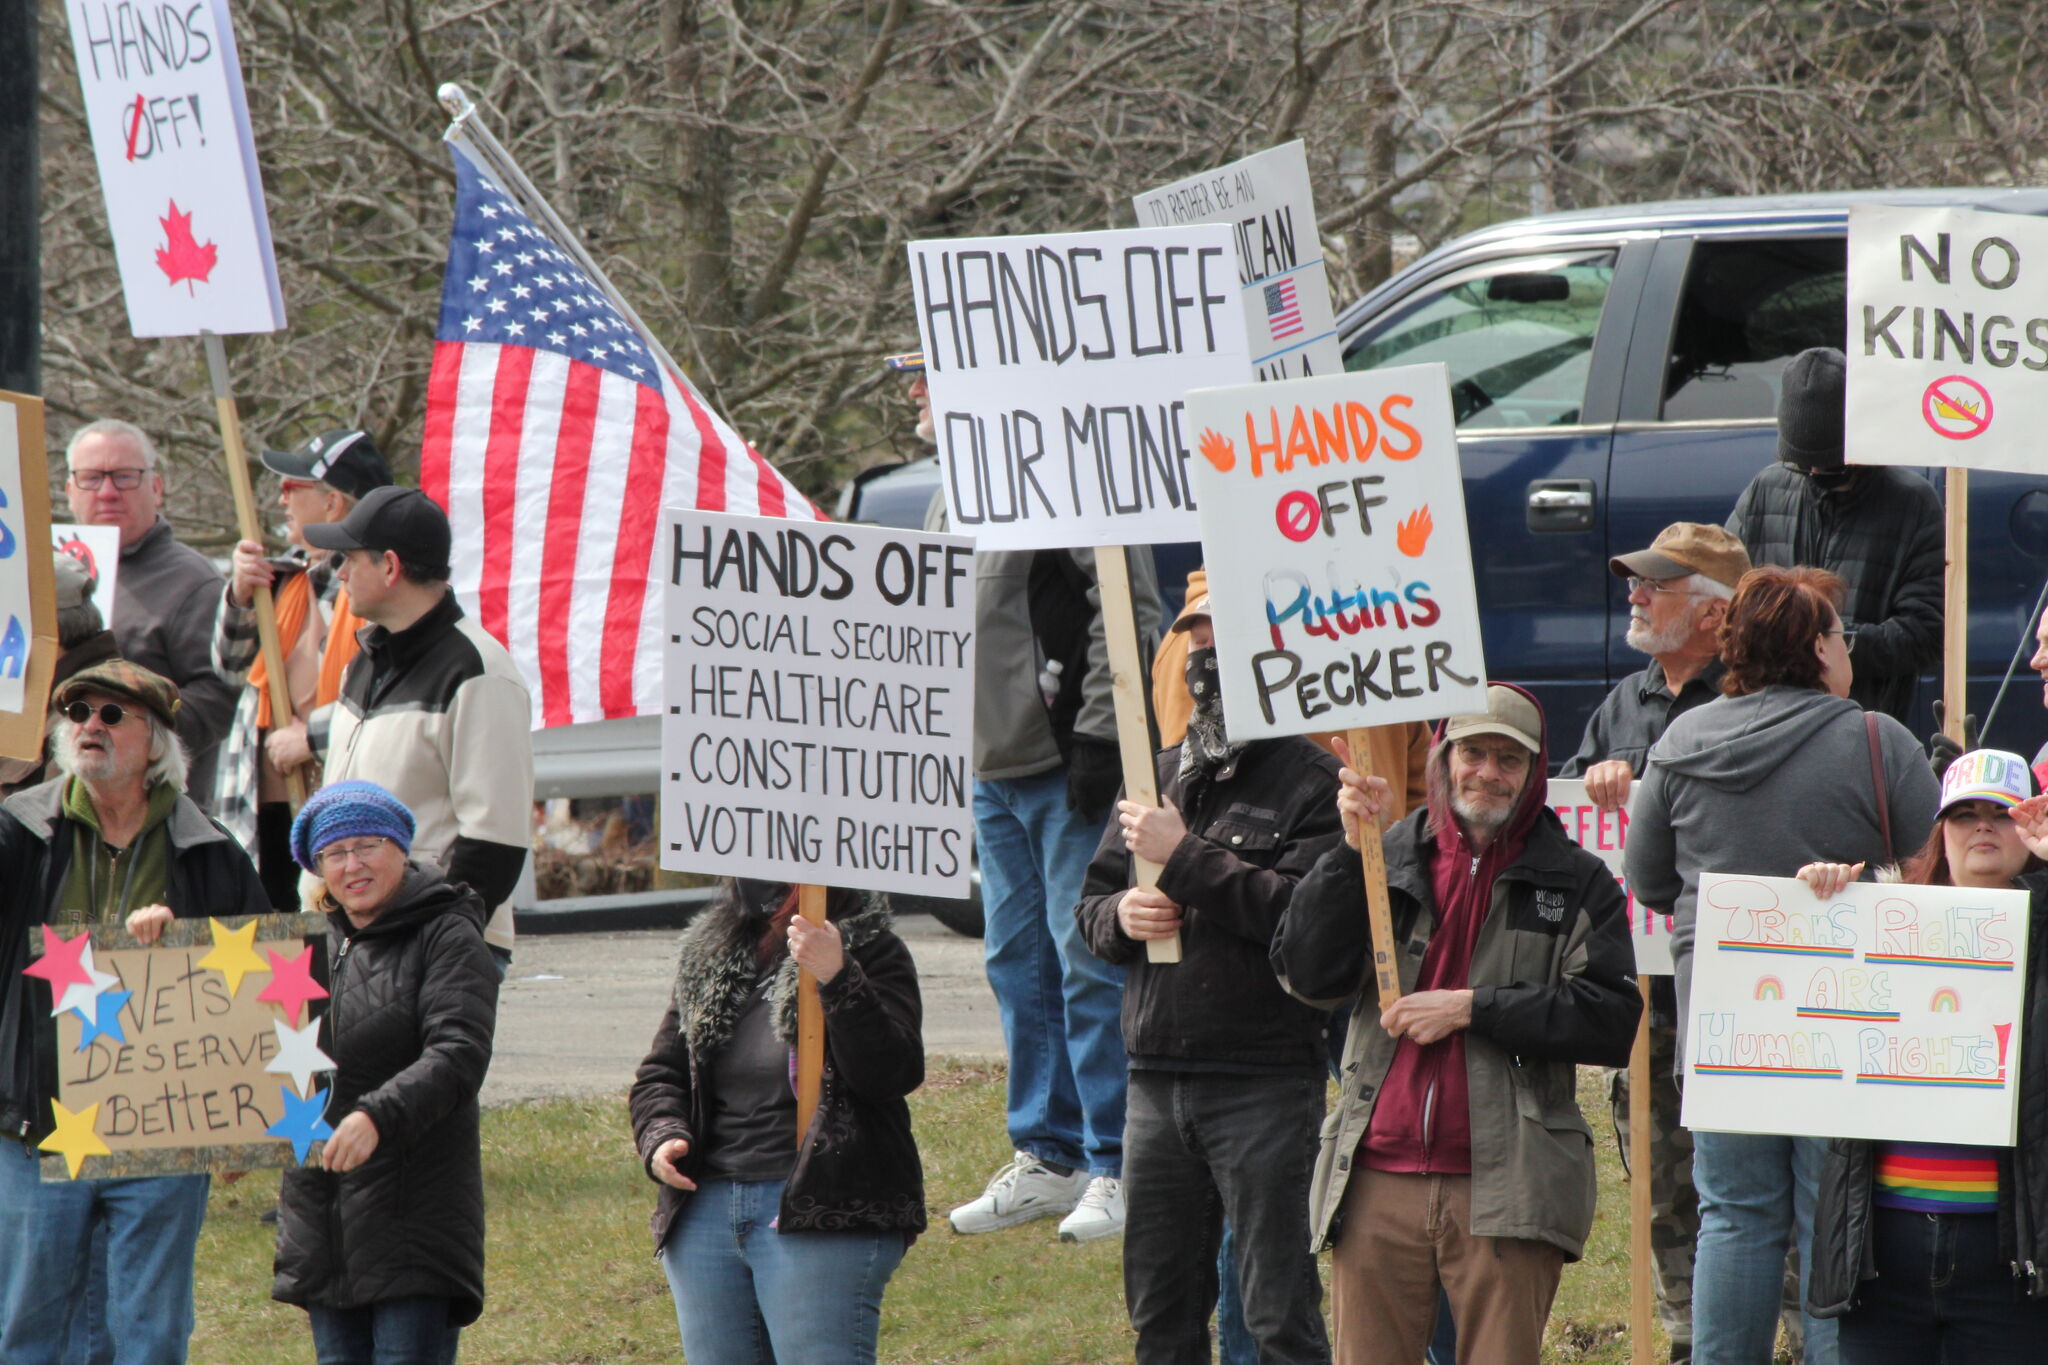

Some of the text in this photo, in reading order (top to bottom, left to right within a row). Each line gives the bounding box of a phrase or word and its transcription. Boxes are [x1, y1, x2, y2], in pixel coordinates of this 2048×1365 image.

[81, 1, 212, 81] HANDS
[122, 93, 206, 163] OFF!
[1168, 183, 1216, 225] RATHER
[1212, 176, 1234, 211] BE
[1234, 168, 1256, 205] AN
[1900, 232, 2021, 290] NO
[917, 244, 1226, 372] HANDS OFF
[1863, 304, 2048, 371] KINGS
[944, 401, 1198, 525] OUR MONE
[1245, 393, 1423, 478] HANDS
[1275, 475, 1388, 543] OFF
[671, 523, 974, 608] HANDS OFF
[691, 606, 972, 669] SOCIAL SECURITY
[691, 664, 952, 738] HEALTHCARE
[1251, 641, 1480, 725] PECKER
[689, 732, 966, 809] CONSTITUTION
[1944, 753, 2024, 797] PRIDE
[685, 801, 961, 878] VOTING RIGHTS
[1805, 966, 1892, 1012] ARE
[67, 1030, 277, 1087] DESERVE
